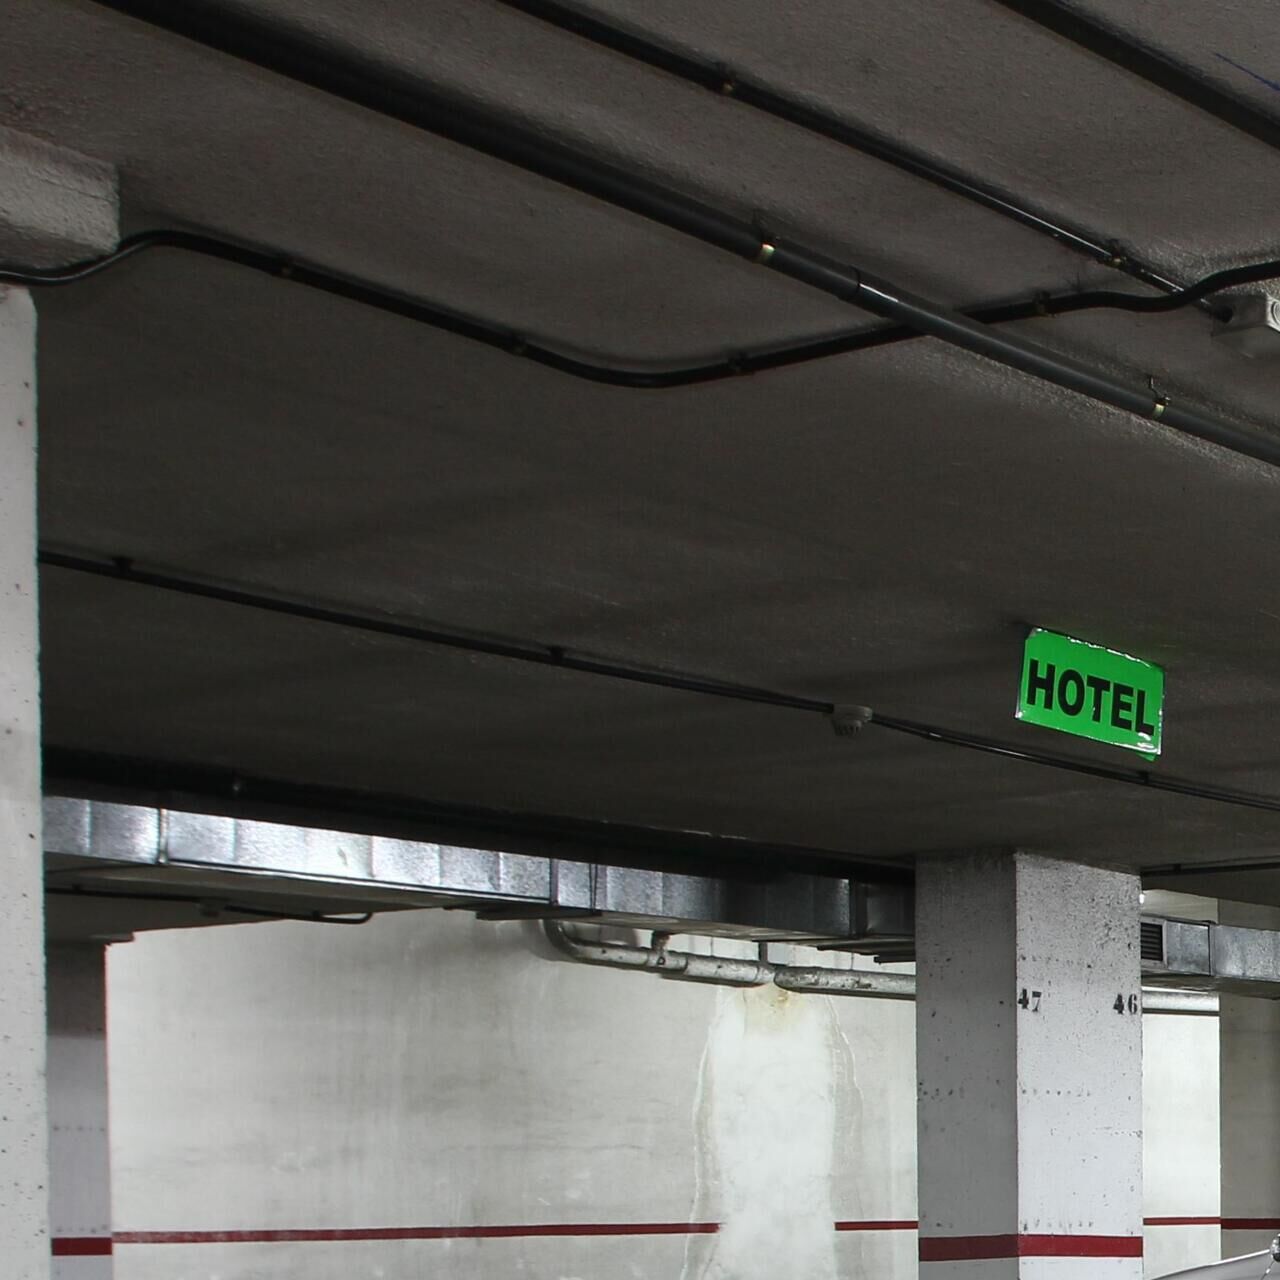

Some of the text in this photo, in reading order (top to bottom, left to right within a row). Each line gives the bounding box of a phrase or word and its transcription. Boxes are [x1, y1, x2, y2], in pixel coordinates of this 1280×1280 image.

[1026, 658, 1155, 737] HOTEL
[1018, 988, 1042, 1013] 47
[1113, 993, 1138, 1015] 46
